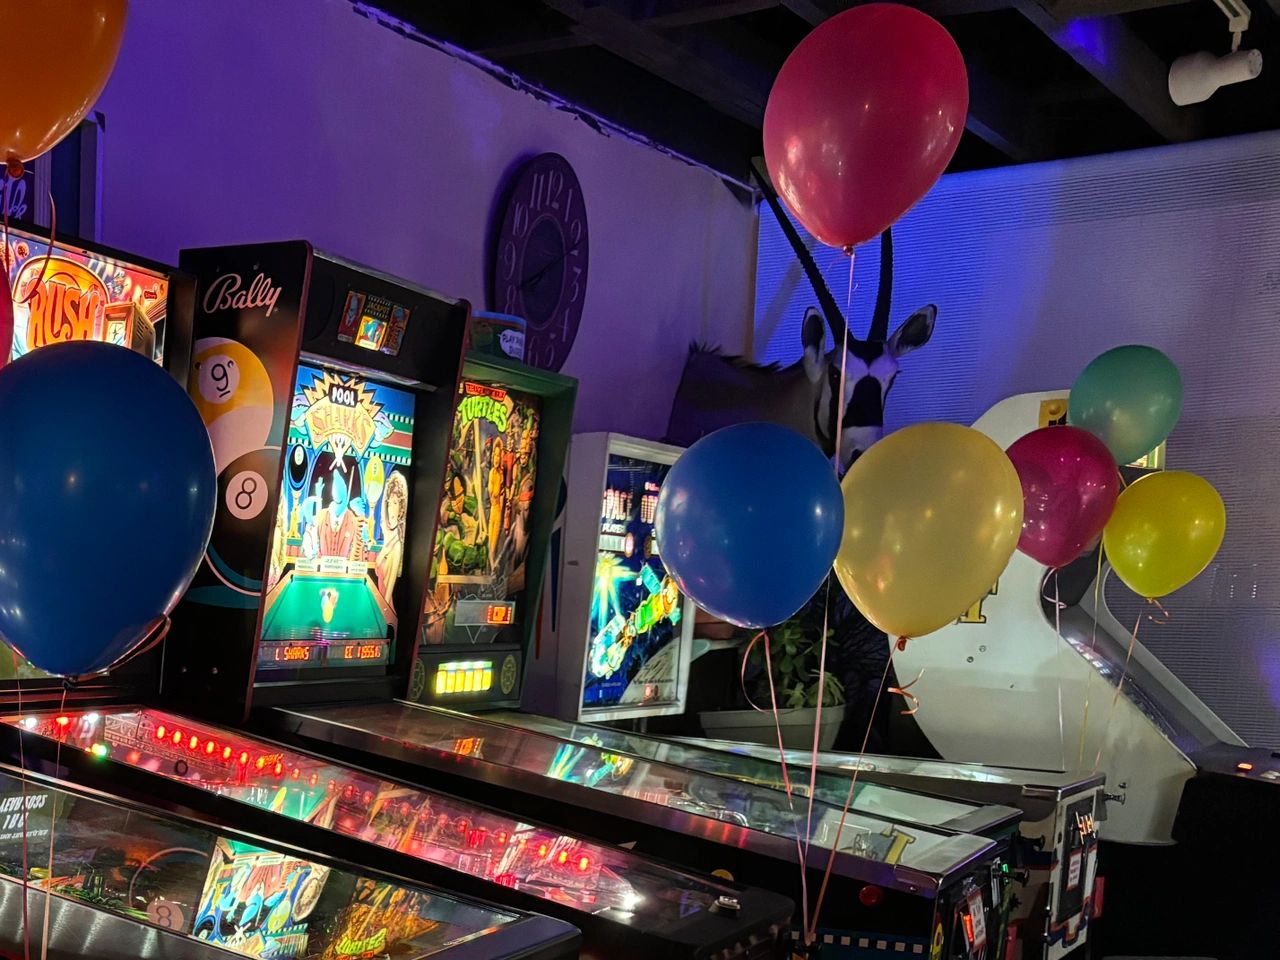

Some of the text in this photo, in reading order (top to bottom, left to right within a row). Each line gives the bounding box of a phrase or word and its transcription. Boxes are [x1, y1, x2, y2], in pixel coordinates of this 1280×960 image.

[546, 169, 564, 209] 12
[27, 276, 100, 350] RUSH
[203, 273, 282, 317] Bally
[331, 387, 355, 406] POOL
[458, 396, 507, 433] TURTLES
[235, 477, 257, 510] 8
